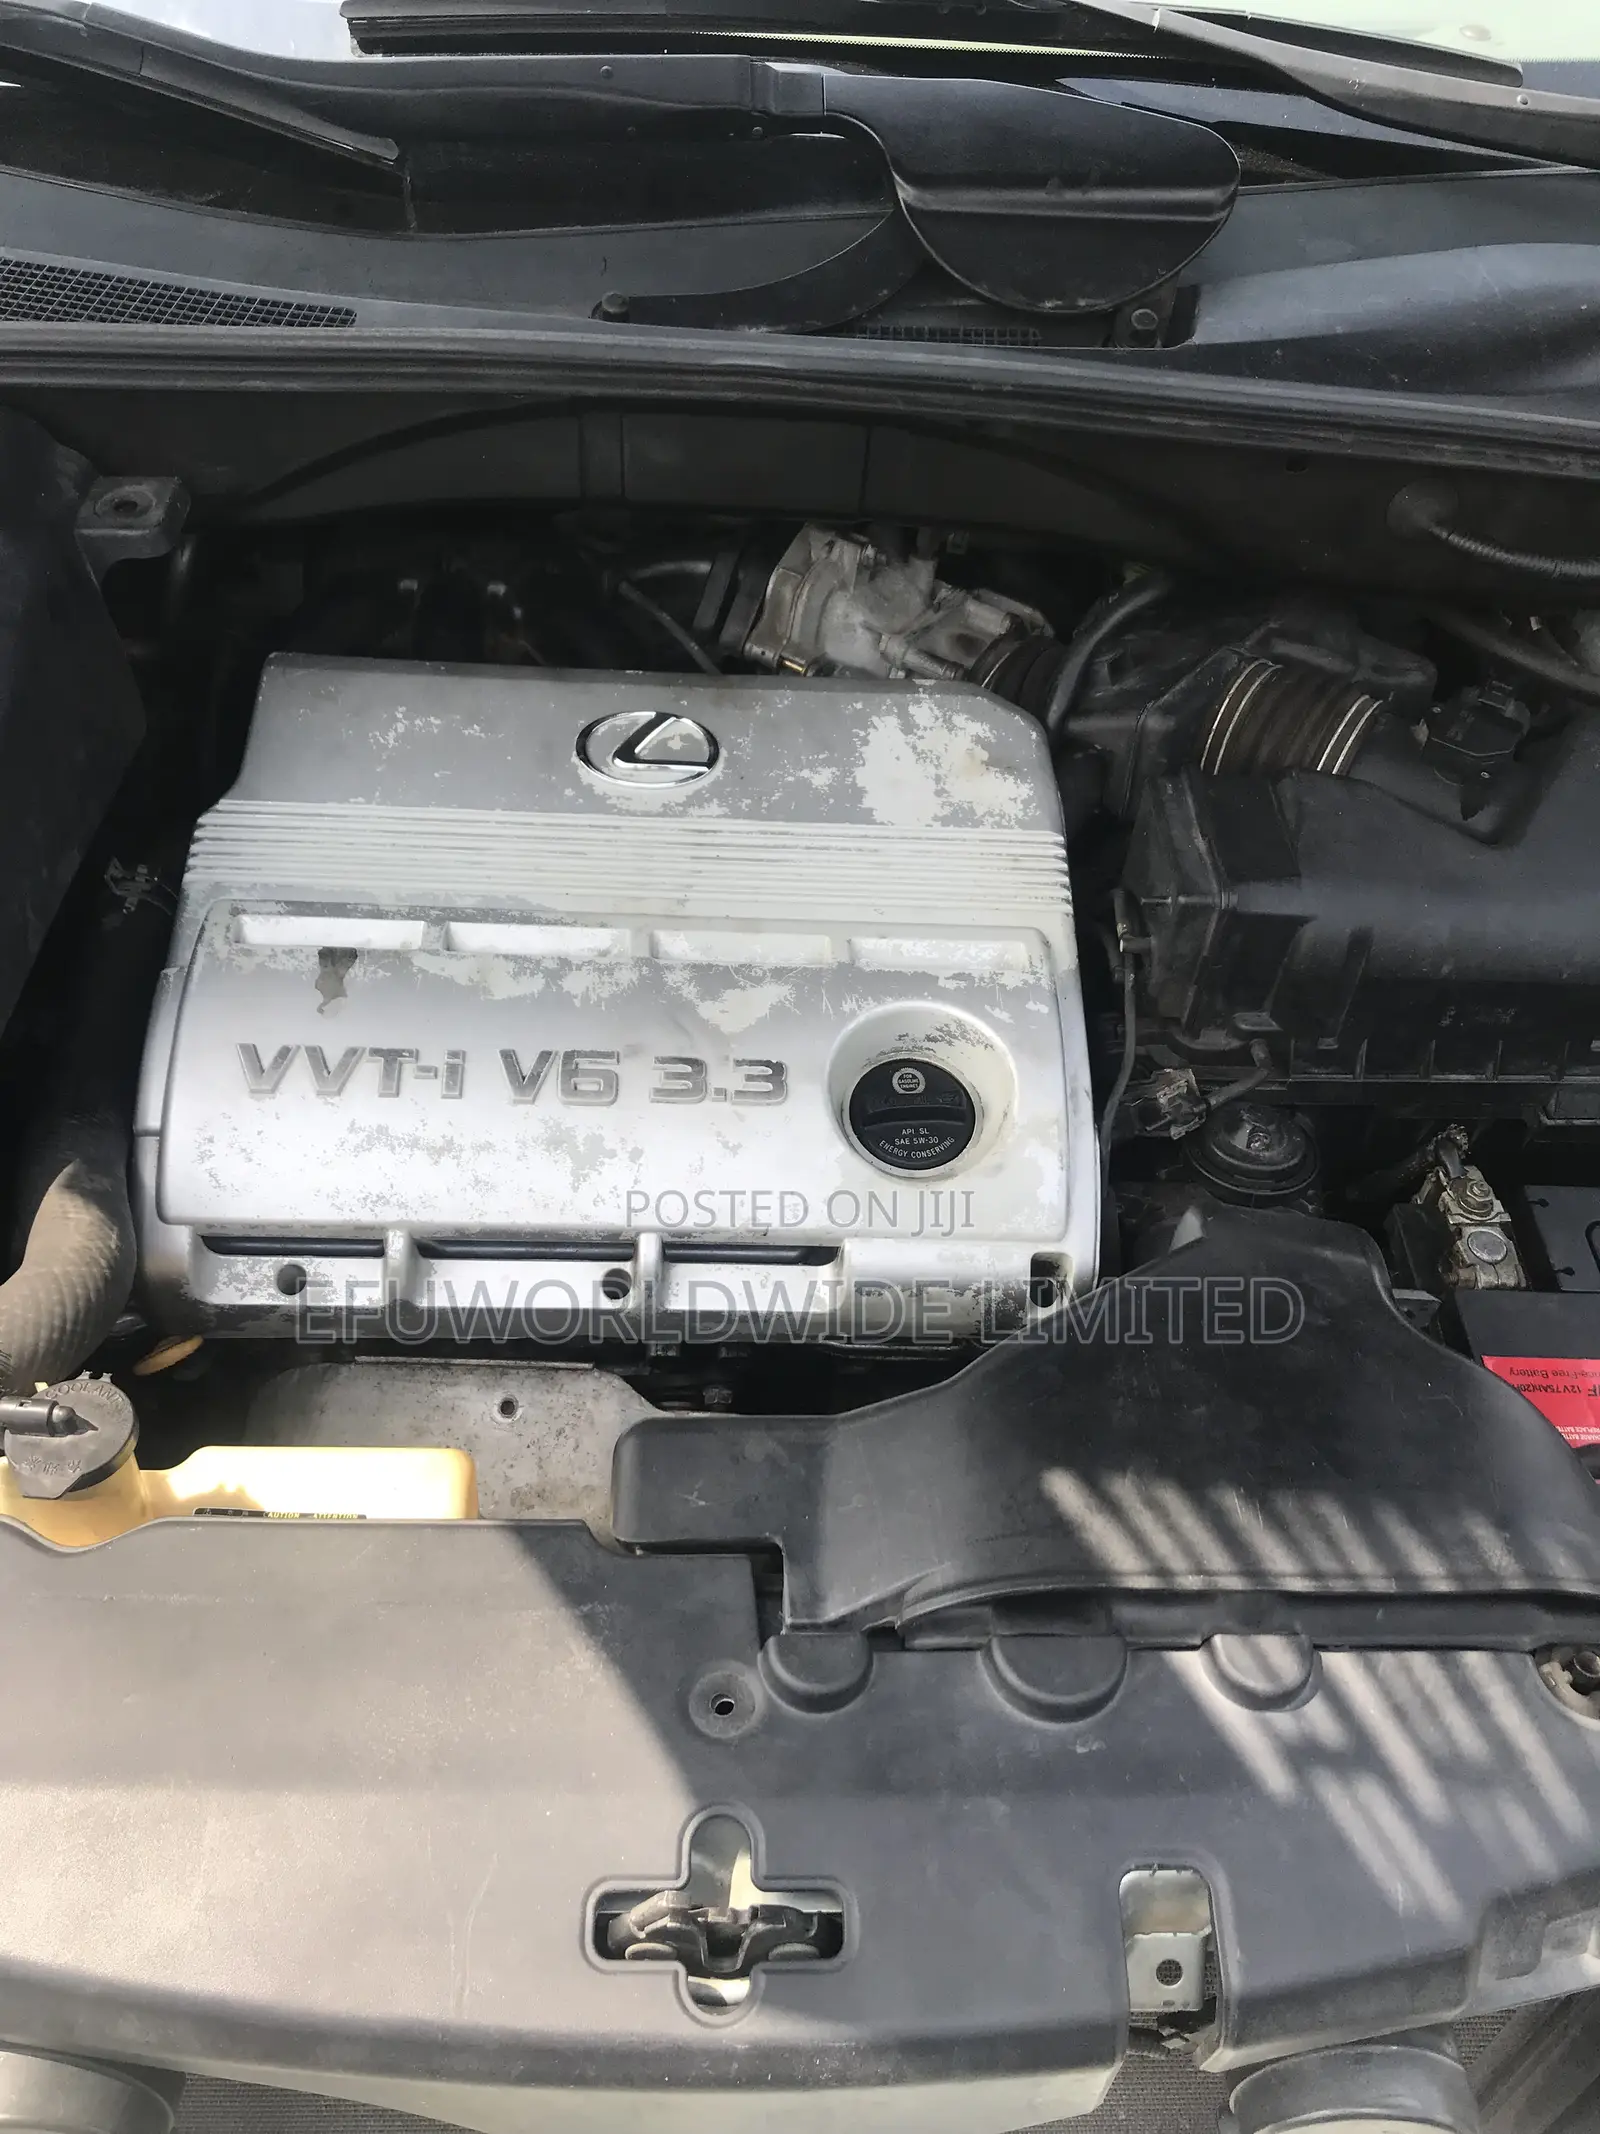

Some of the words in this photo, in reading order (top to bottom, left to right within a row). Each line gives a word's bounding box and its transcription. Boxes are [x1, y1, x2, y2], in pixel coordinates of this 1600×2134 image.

[236, 1043, 466, 1099] VVT-i
[498, 1048, 619, 1105] V6
[650, 1055, 788, 1105] 3.3
[902, 1128, 915, 1136] API
[919, 1127, 930, 1135] SL
[879, 1139, 909, 1157] ENERGY
[910, 1136, 955, 1159] CONSERVING
[894, 1137, 911, 1146] SAE
[913, 1136, 939, 1145] 5W-30
[1509, 1366, 1549, 1379] Battery
